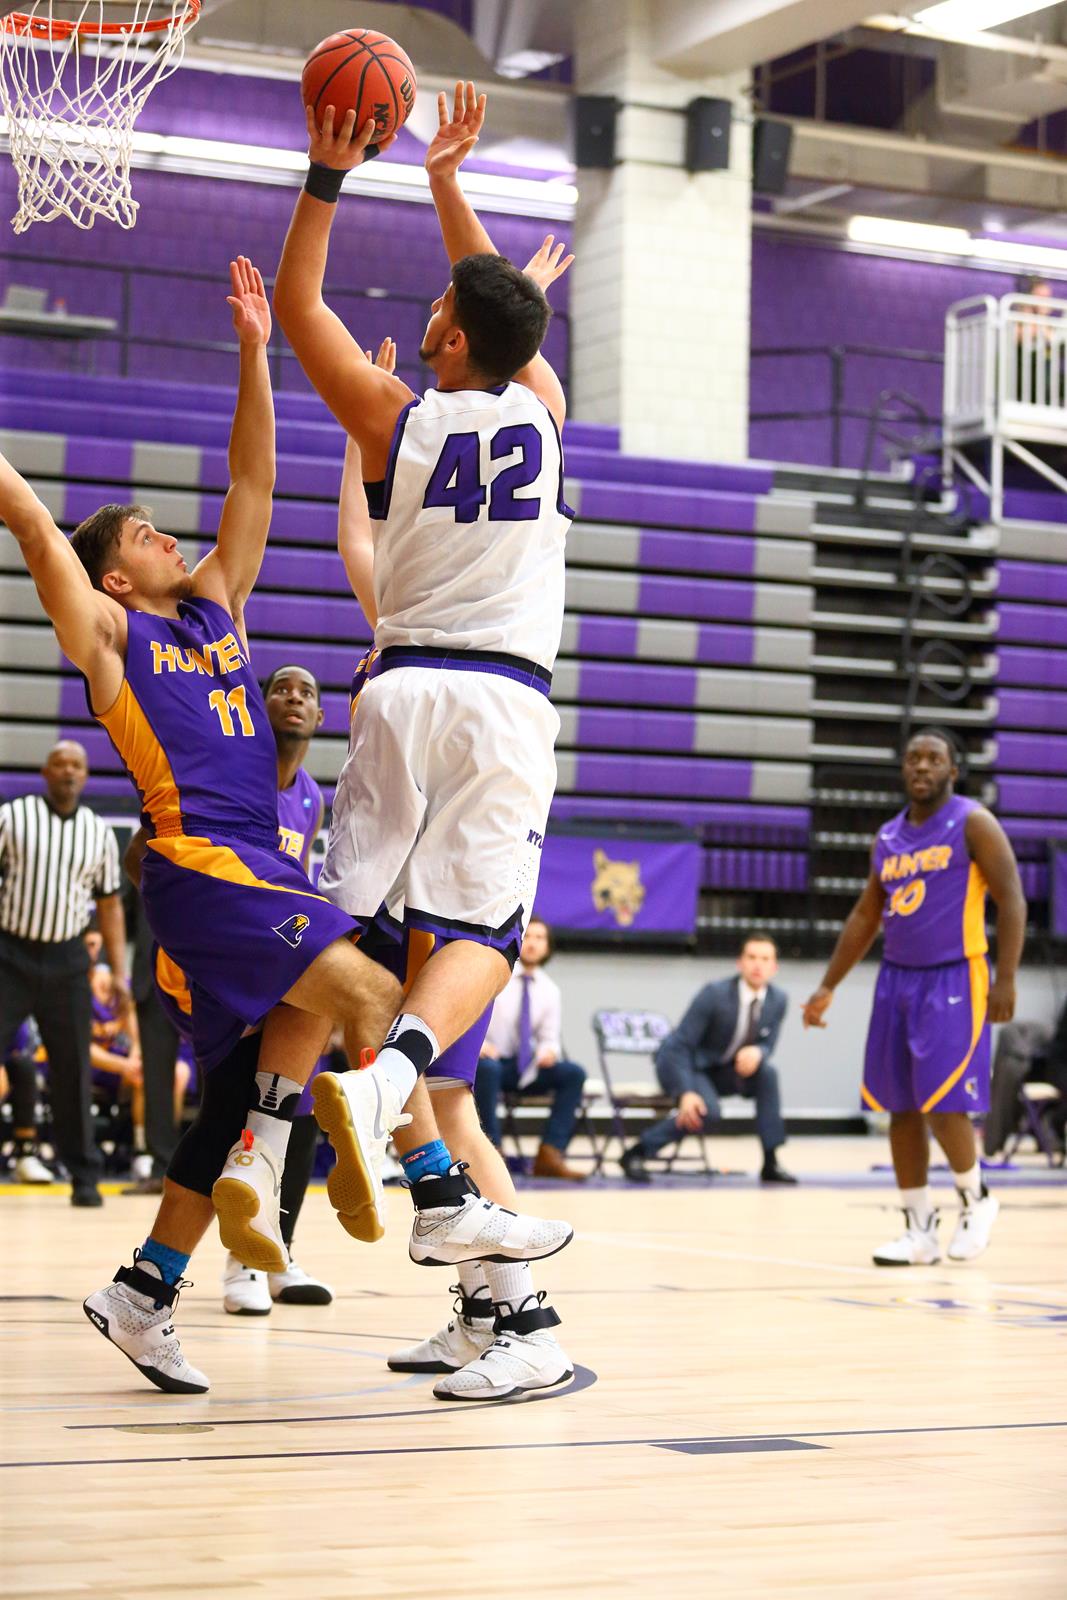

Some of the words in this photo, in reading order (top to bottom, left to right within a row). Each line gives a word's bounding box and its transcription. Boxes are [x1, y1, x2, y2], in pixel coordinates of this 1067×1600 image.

[422, 423, 542, 523] 42
[208, 685, 255, 736] 11
[881, 845, 953, 882] HUNTER
